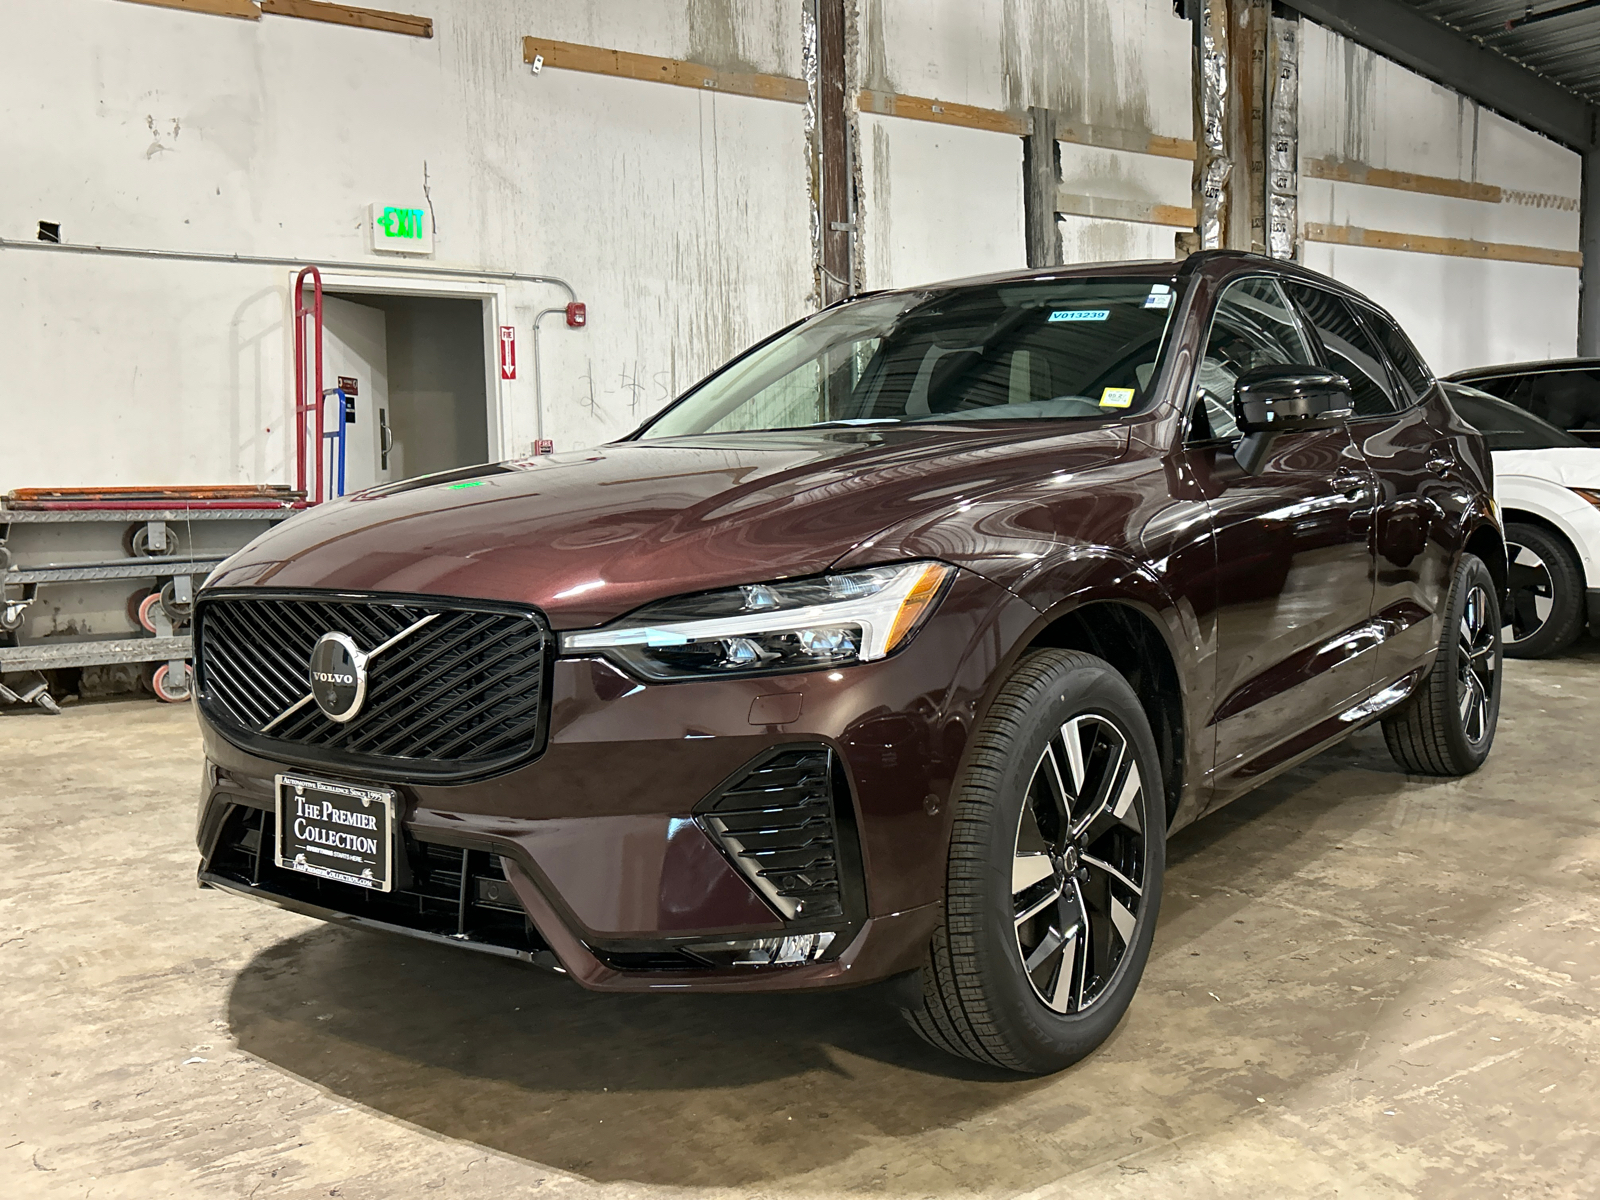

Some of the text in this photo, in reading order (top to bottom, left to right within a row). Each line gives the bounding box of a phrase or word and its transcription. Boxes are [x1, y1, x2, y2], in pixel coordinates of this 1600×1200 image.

[384, 206, 425, 240] EXIT
[313, 671, 353, 684] VOLVO
[283, 776, 383, 801] AUTOMOTIVE EXCELLENCE SINCE 1995
[294, 796, 378, 831] THE PREMIER
[294, 817, 378, 855] COLLECTION
